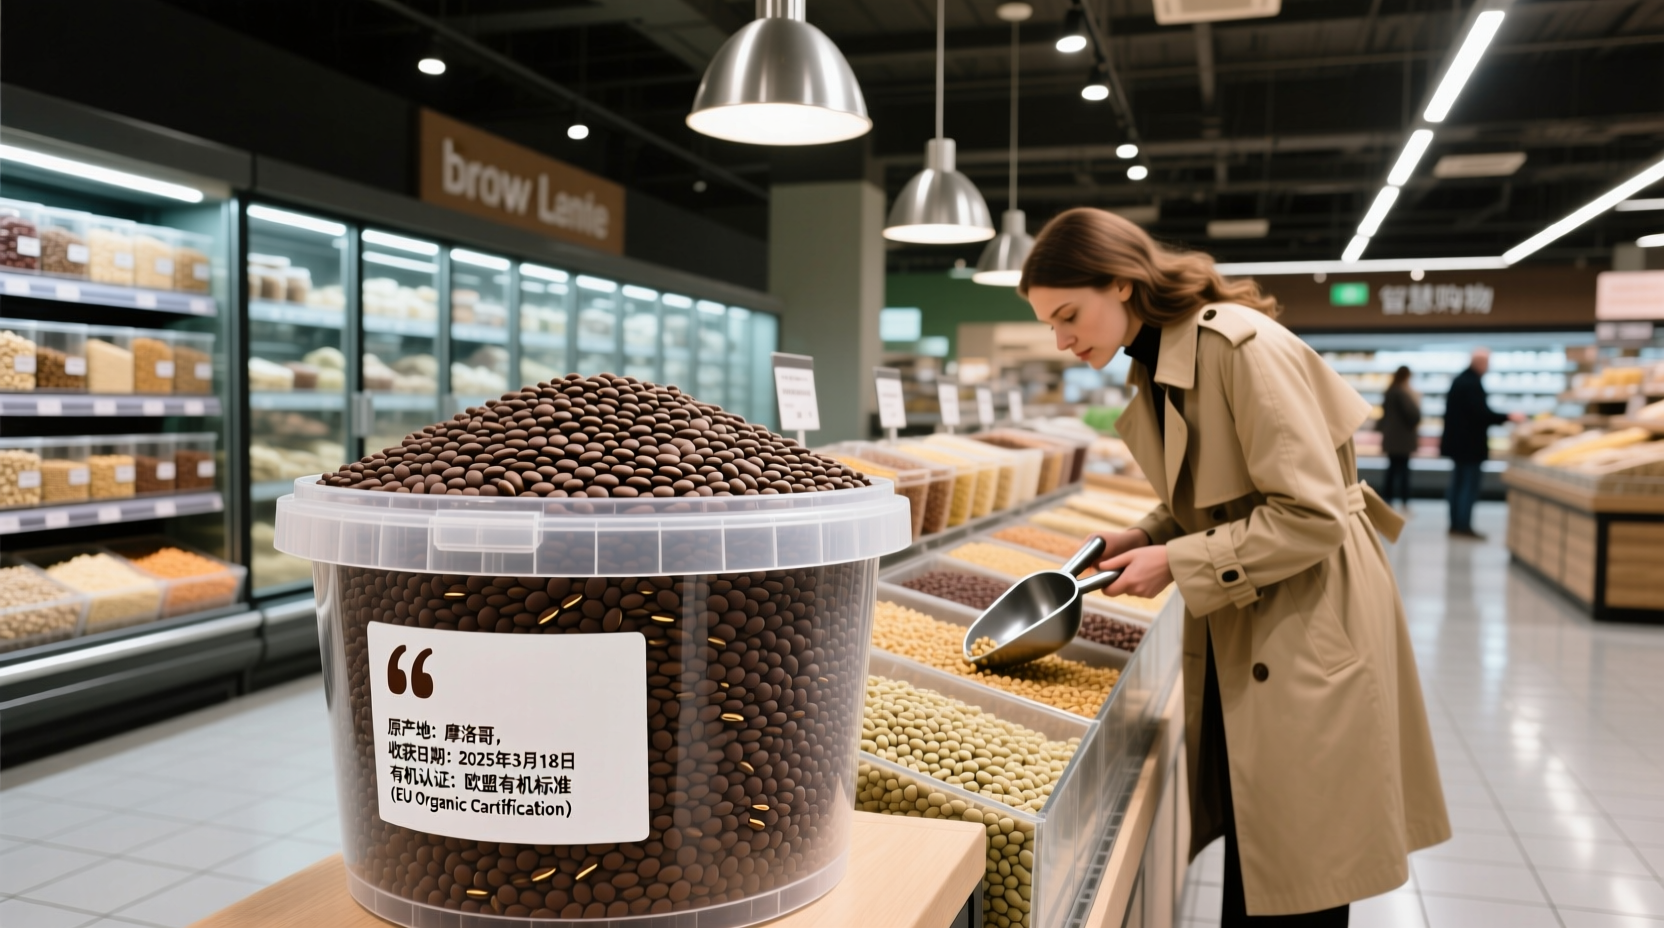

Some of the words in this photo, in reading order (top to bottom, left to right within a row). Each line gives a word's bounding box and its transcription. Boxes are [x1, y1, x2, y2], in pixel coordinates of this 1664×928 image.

[442, 137, 531, 215] brow
[390, 786, 413, 804] (EU
[415, 791, 468, 813] Organic
